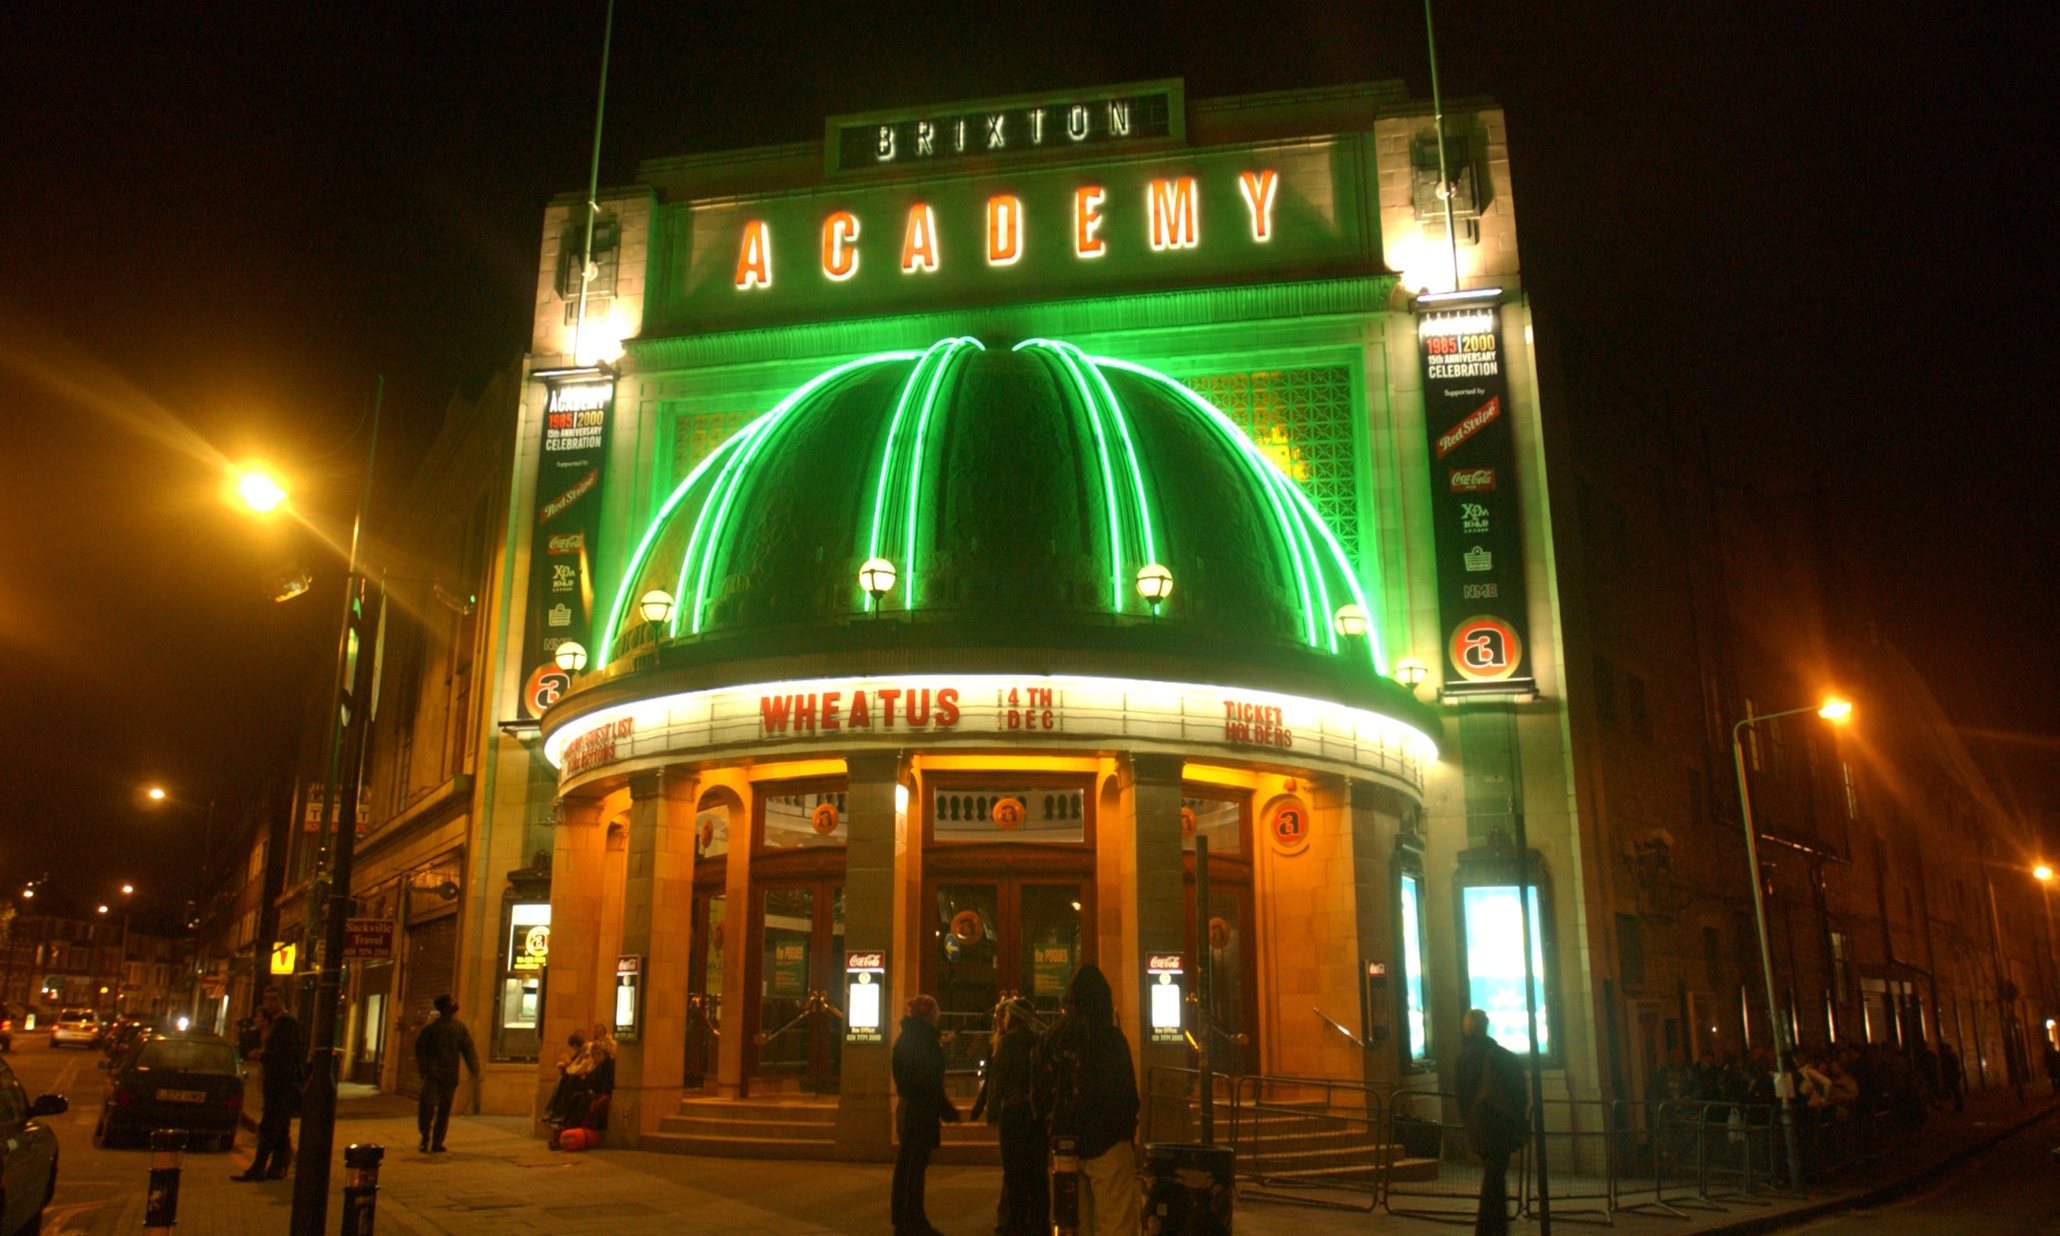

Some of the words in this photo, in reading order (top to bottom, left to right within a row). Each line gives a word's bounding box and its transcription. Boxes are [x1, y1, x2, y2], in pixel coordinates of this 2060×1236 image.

[876, 99, 1129, 161] BRIXTON
[735, 170, 1278, 289] ACADEMY
[1427, 336, 1457, 354] 1985
[1463, 334, 1495, 352] 2000
[1428, 355, 1444, 364] 15th
[1445, 351, 1496, 363] ANNIVERSARY
[1429, 362, 1498, 379] CELEBRATION
[1444, 388, 1477, 397] Supported
[1477, 387, 1485, 395] by
[548, 413, 573, 429] 1985
[578, 411, 604, 426] 2000
[1439, 430, 1463, 452] Red
[1463, 402, 1496, 435] Stripe
[560, 427, 602, 438] ANNIVERSARY
[546, 436, 602, 451] CELEBRATION
[544, 500, 566, 518] Red
[566, 474, 594, 503] Stripe
[1464, 583, 1498, 599] NME
[1008, 687, 1019, 707] 4
[1027, 687, 1053, 706] TH
[760, 687, 960, 733] WHEATUS
[1007, 709, 1054, 730] DEC
[1223, 700, 1282, 727] TICKET
[612, 716, 634, 740] LIST
[1225, 721, 1293, 748] HOLDERS
[345, 922, 392, 934] Sackville
[353, 934, 384, 945] Travel
